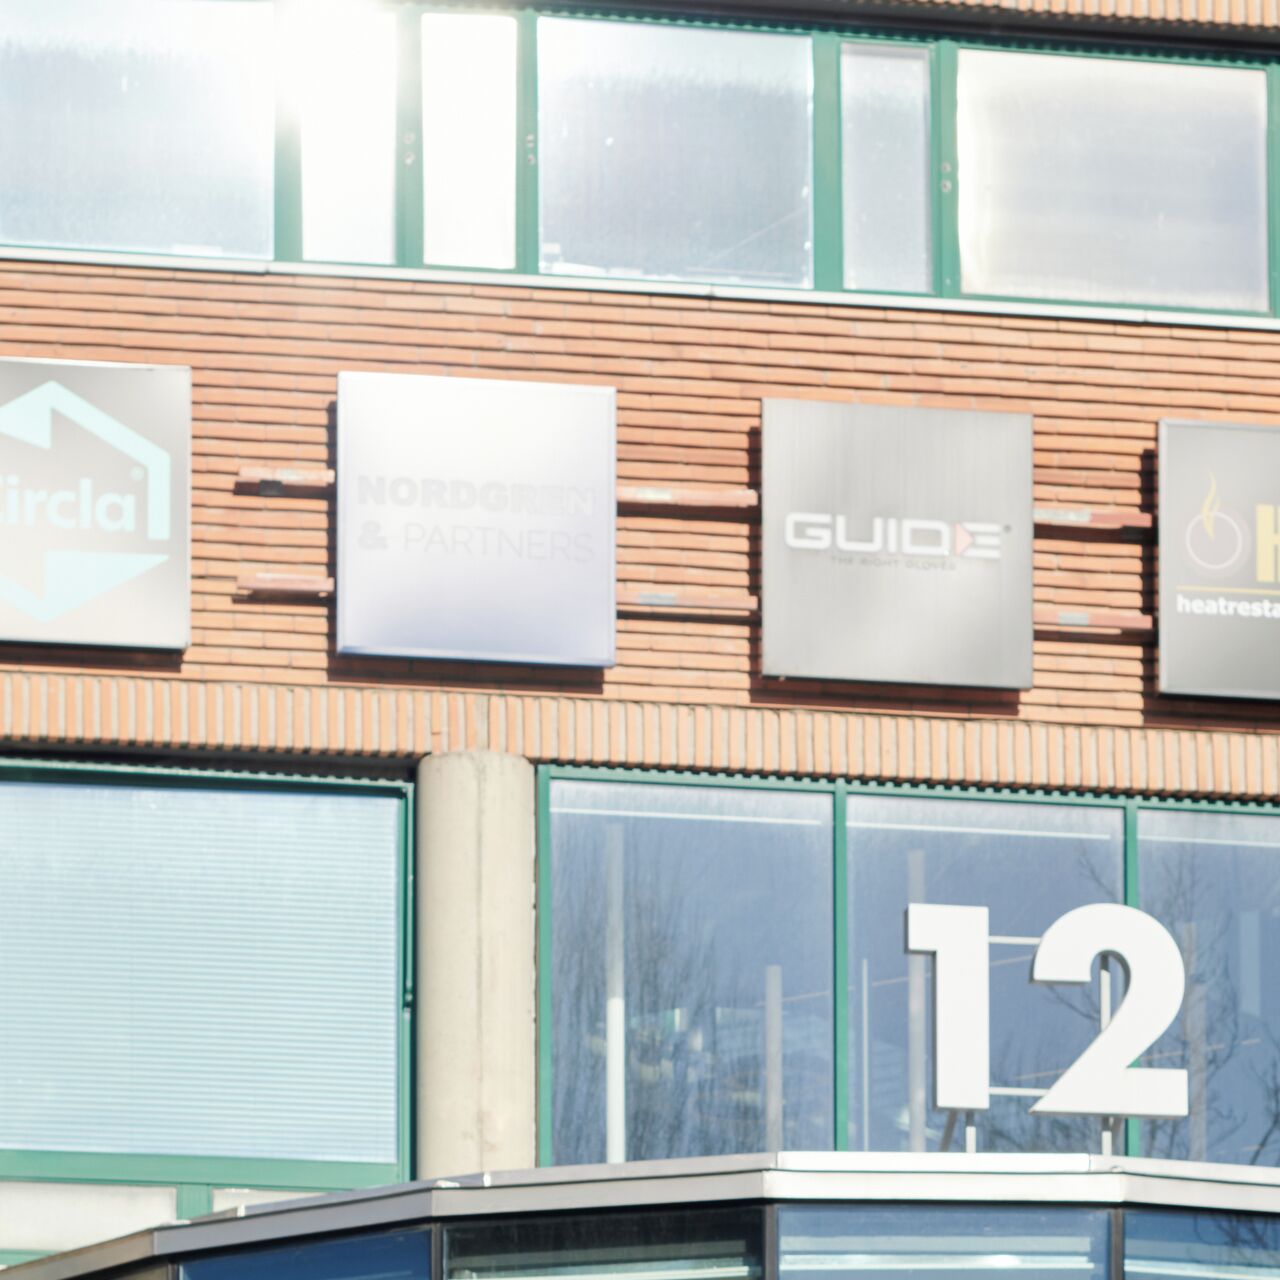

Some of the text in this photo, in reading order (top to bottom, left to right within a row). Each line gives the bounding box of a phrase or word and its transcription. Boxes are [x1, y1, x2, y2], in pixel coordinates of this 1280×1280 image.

[357, 475, 599, 516] NORDGREN
[358, 521, 596, 562] & PARTNERS
[784, 512, 1003, 560] GUIDE
[860, 559, 899, 568] RIGHT
[906, 902, 1189, 1117] 12
